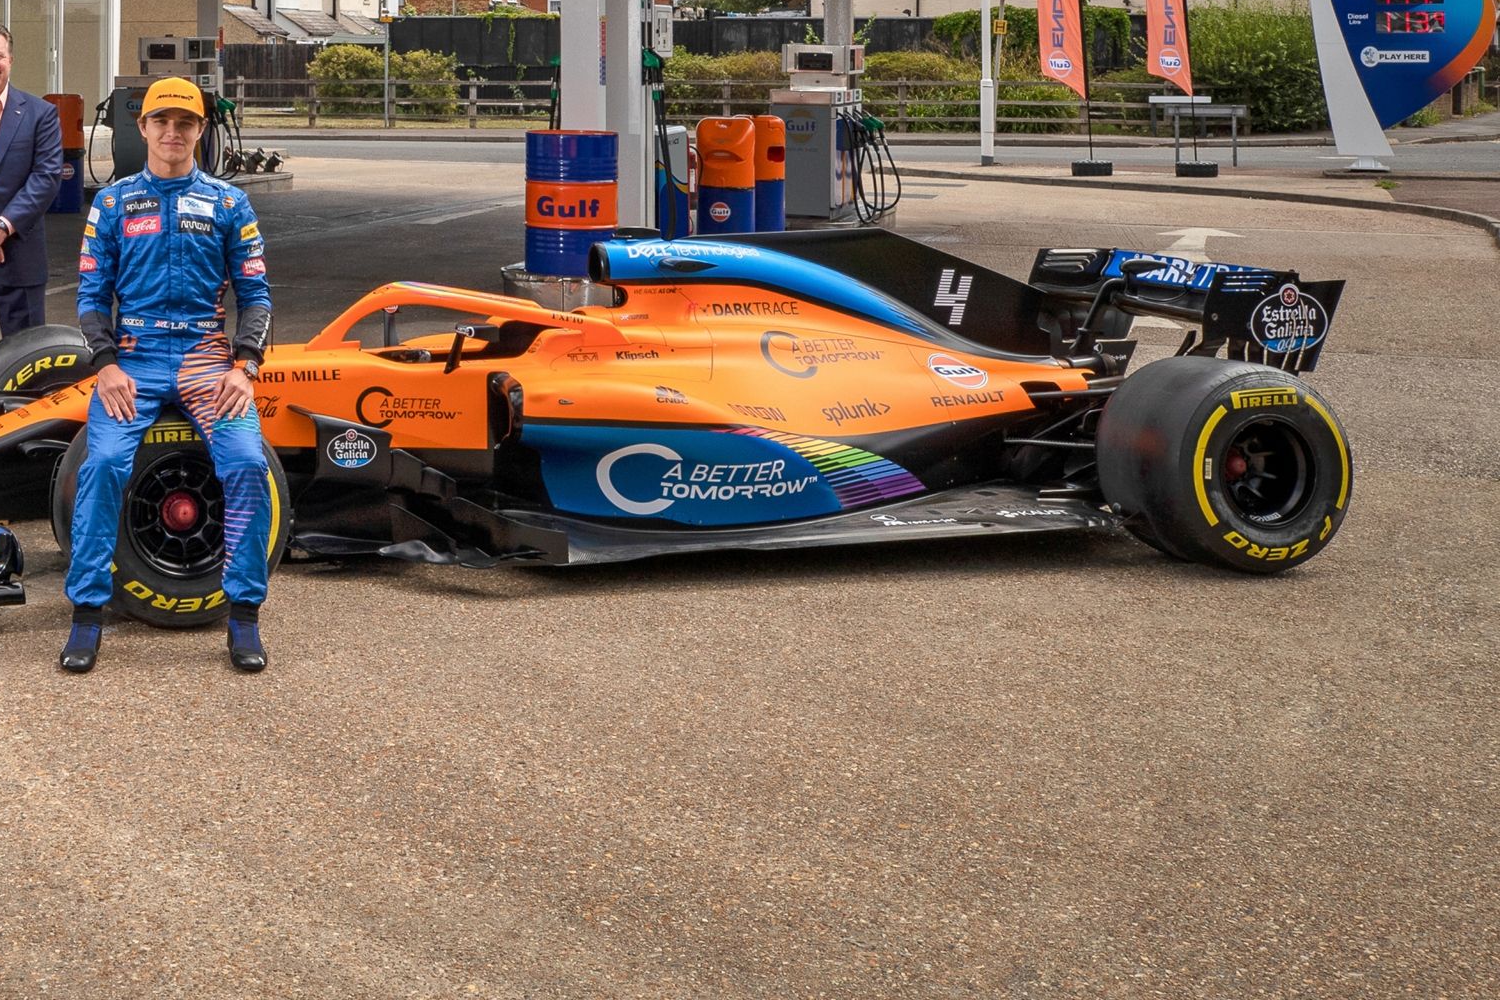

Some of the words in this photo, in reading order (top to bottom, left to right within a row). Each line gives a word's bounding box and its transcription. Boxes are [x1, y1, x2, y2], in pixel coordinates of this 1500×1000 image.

[995, 21, 1005, 33] H
[786, 119, 816, 132] Gulf
[126, 200, 158, 213] splunk>
[536, 196, 600, 218] Gulf
[711, 208, 729, 216] Gulf
[626, 244, 672, 259] DELL
[674, 243, 761, 259] Technologies
[80, 259, 93, 269] Pro
[934, 269, 973, 325] 4
[712, 301, 800, 317] DARKTRACE
[791, 340, 801, 353] A
[802, 338, 856, 352] BETTER
[615, 350, 660, 362] Klipsch
[254, 371, 285, 384] ARD
[291, 369, 341, 382] MILLE
[933, 365, 980, 378] Gulf
[379, 397, 390, 409] A
[392, 397, 442, 409] BETTER
[930, 390, 1005, 408] RENAULT
[1230, 387, 1298, 410] PIRELLI
[821, 398, 891, 426] splunk>
[333, 440, 370, 451] Estrella
[335, 449, 368, 460] Galicia
[662, 462, 683, 481] A
[689, 459, 786, 483] BETTER
[1319, 515, 1332, 541] P
[1223, 530, 1310, 561] ZERO
[123, 580, 227, 613] ZERO
